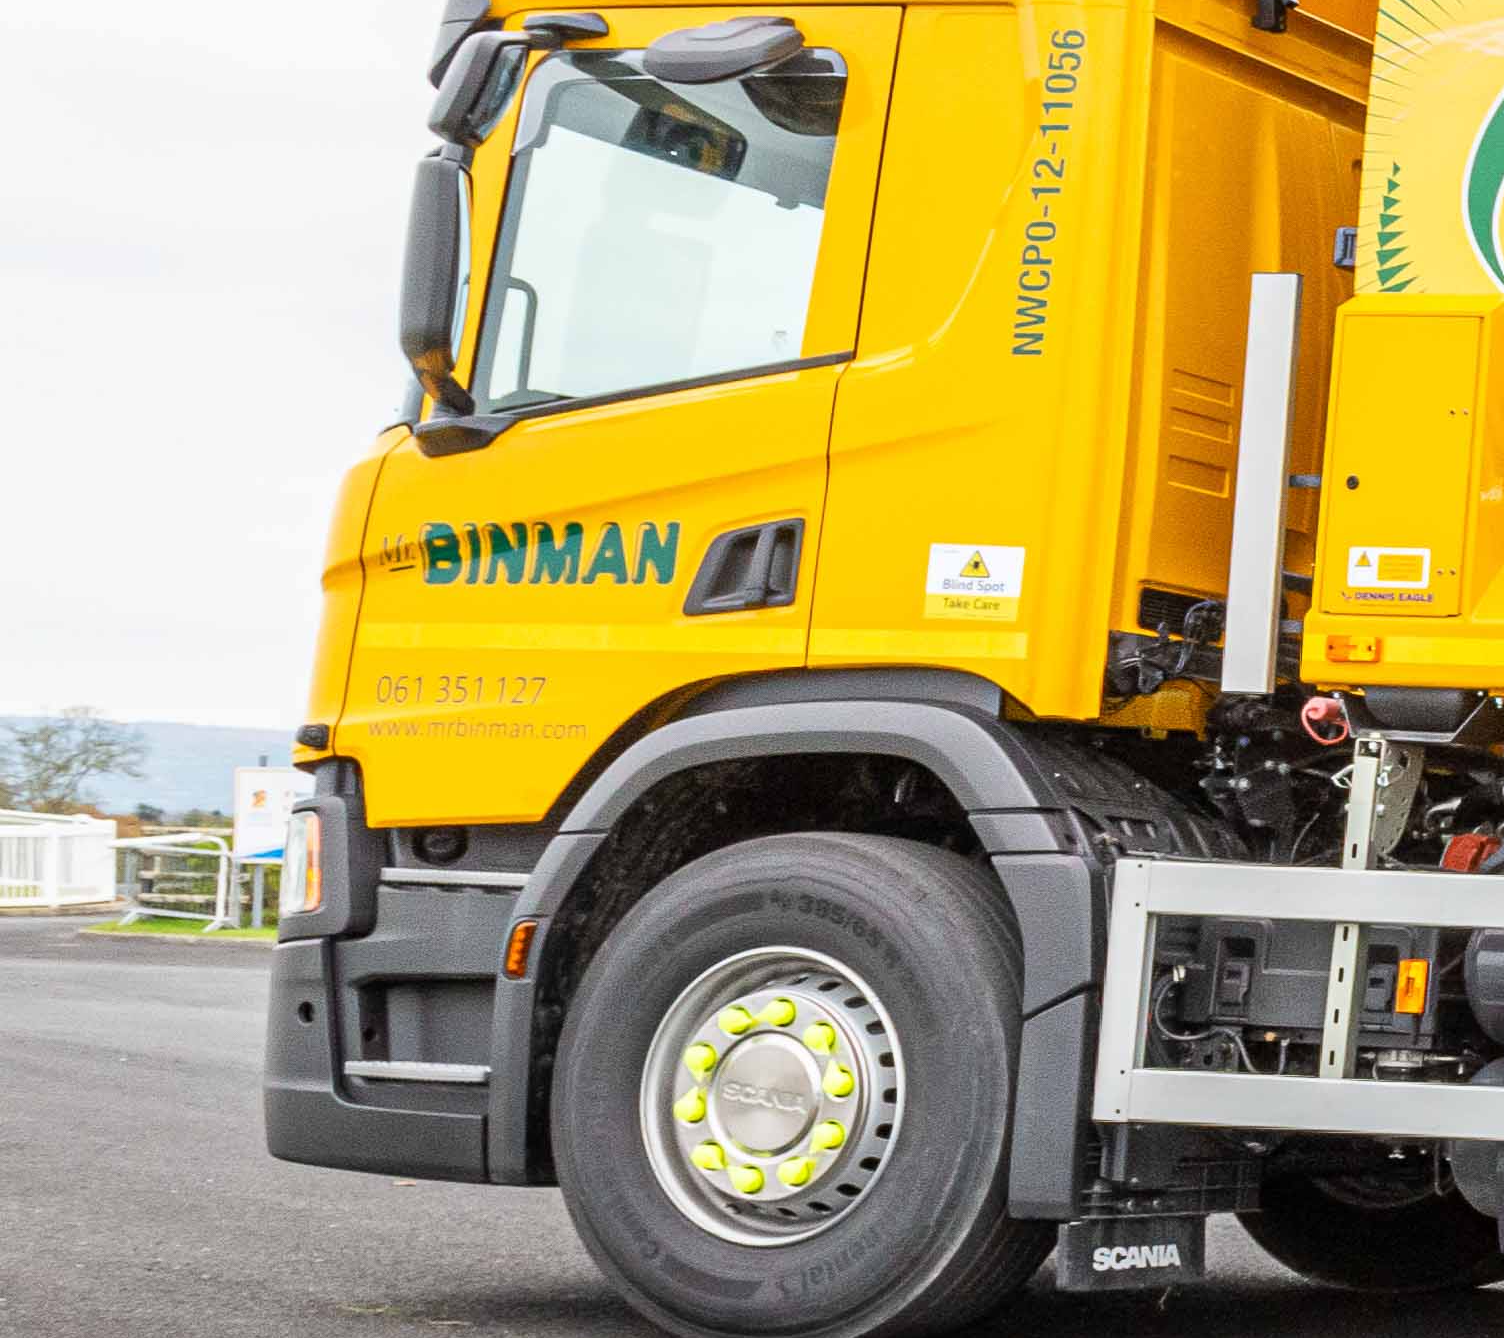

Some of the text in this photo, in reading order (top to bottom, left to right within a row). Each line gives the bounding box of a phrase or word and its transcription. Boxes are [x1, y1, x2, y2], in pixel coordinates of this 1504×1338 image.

[420, 521, 681, 585] BINMAN
[942, 579, 1005, 593] Blind Spot
[943, 597, 1000, 610] Take Care
[376, 675, 547, 705] 061 351 127
[368, 716, 588, 740] www.mrbinman.com
[1092, 1244, 1180, 1271] SCANIA
